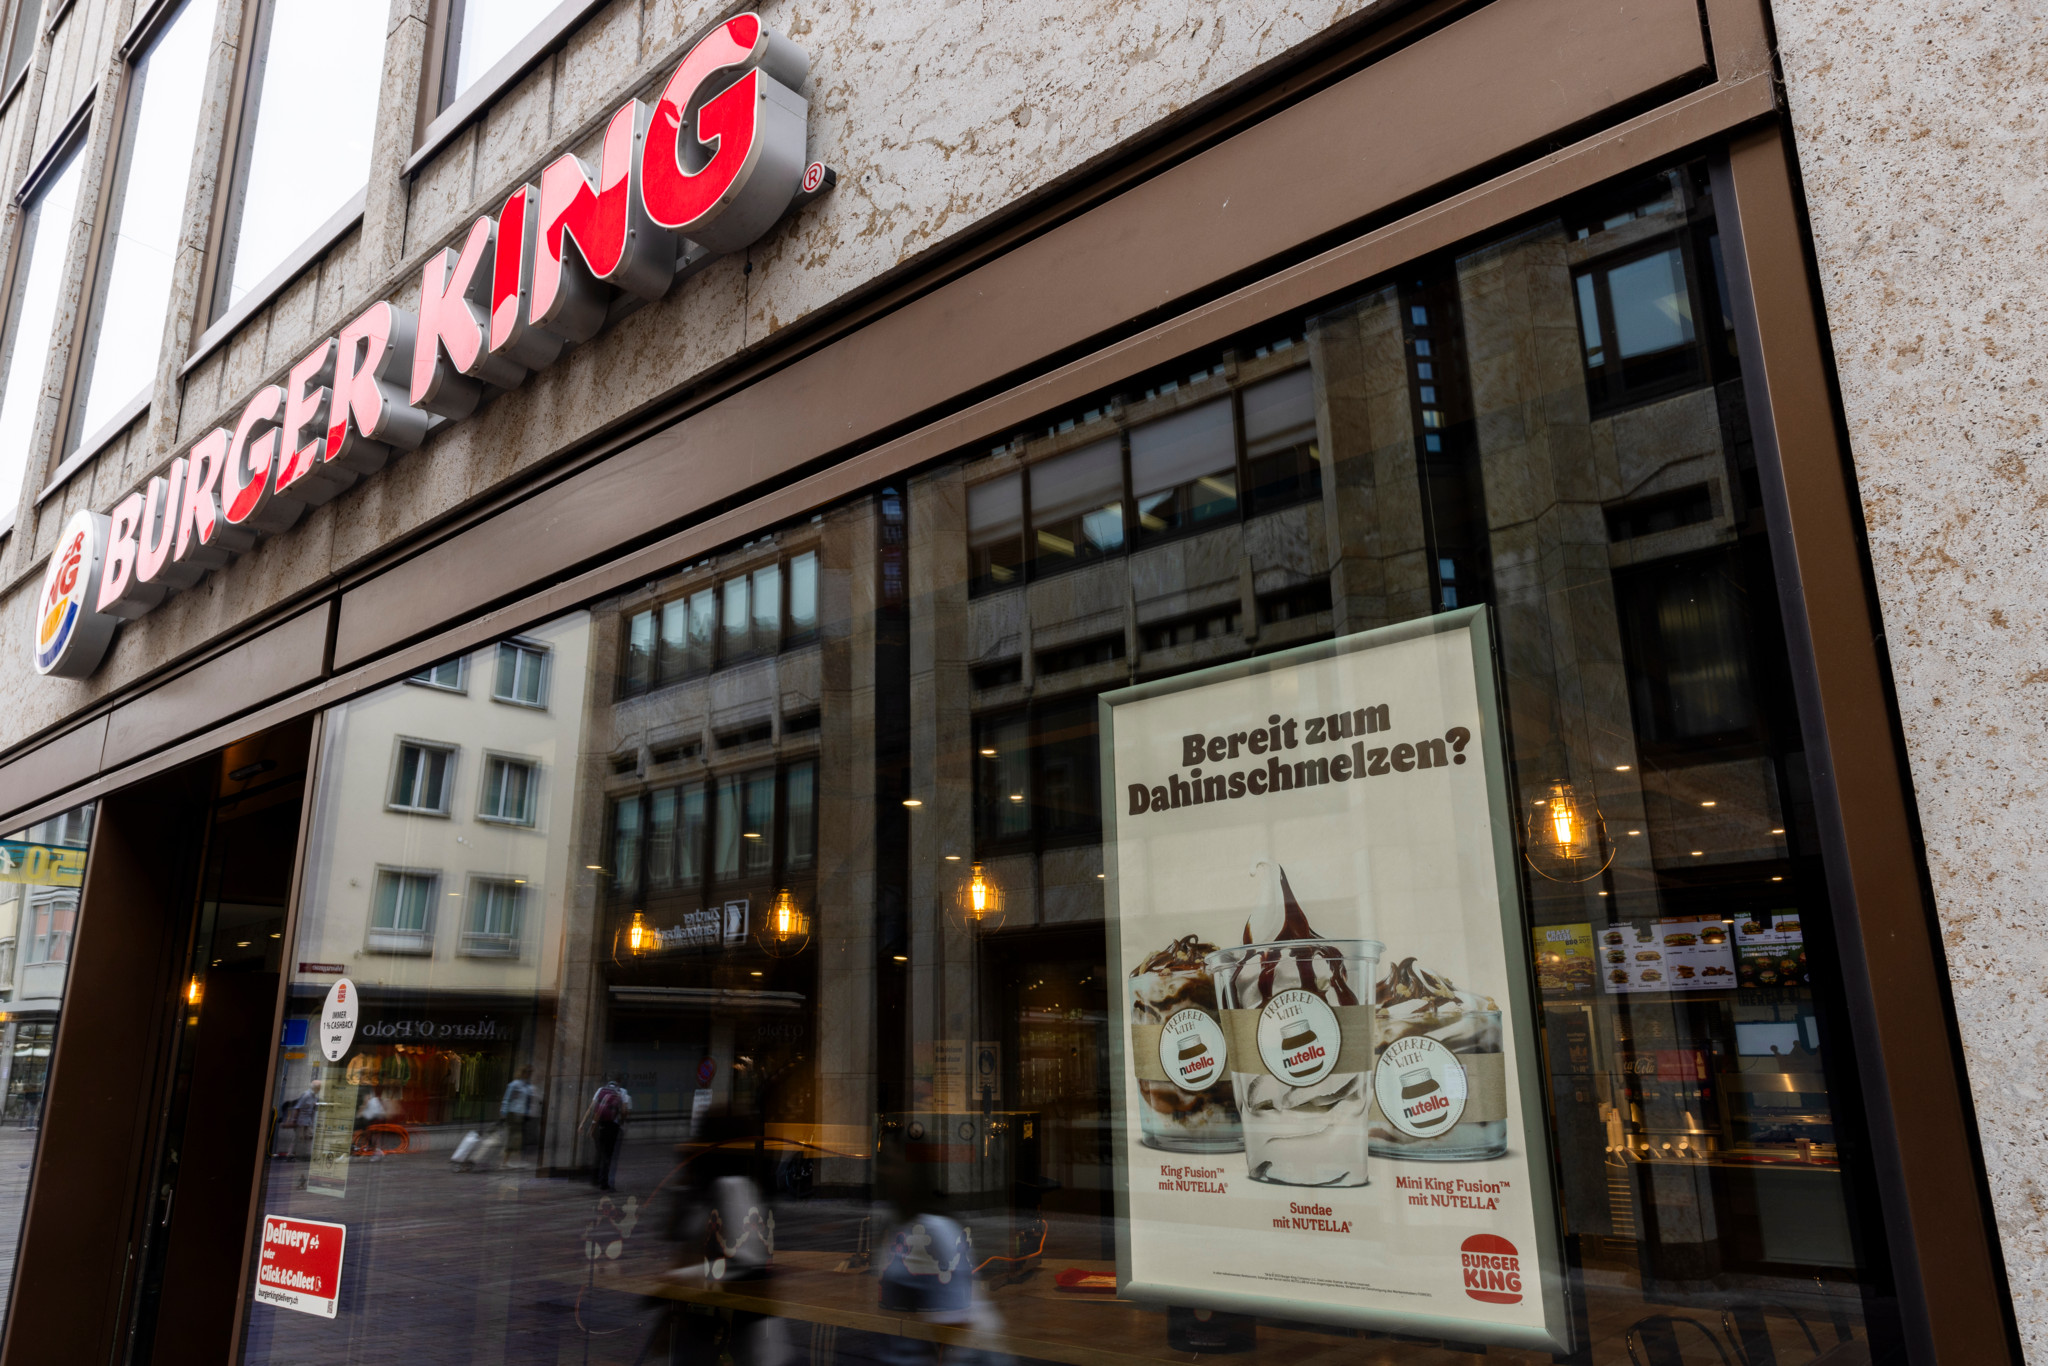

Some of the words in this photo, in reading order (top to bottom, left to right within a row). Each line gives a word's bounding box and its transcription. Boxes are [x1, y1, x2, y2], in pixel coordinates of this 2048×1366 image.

[96, 301, 392, 613] BURGER
[410, 12, 761, 406] KING
[1182, 713, 1299, 768] Bereit
[1305, 703, 1392, 745] zum
[1128, 726, 1471, 816] Dahinschmelzen?
[1264, 992, 1313, 1019] PREPARED
[1276, 1004, 1303, 1020] WITH
[332, 1011, 347, 1019] IMMER
[1166, 1011, 1205, 1034] PREPARED
[331, 1020, 354, 1030] CASHBACK
[1175, 1021, 1196, 1035] WITH
[1283, 1045, 1326, 1069] nutella
[1382, 1038, 1435, 1066] PREPARED
[1395, 1051, 1423, 1068] WITH
[1180, 1056, 1214, 1076] nutella
[1403, 1095, 1450, 1118] nutella
[1160, 1165, 1183, 1180] King
[1159, 1179, 1174, 1191] mit
[1396, 1176, 1422, 1189] Mini
[1424, 1177, 1454, 1194] King
[1408, 1193, 1429, 1206] mit
[1290, 1202, 1333, 1216] Sundae
[1272, 1216, 1290, 1229] mit
[266, 1222, 310, 1254] Delivery
[264, 1248, 276, 1259] oder
[1461, 1253, 1520, 1272] BURGER
[1463, 1268, 1522, 1292] KING
